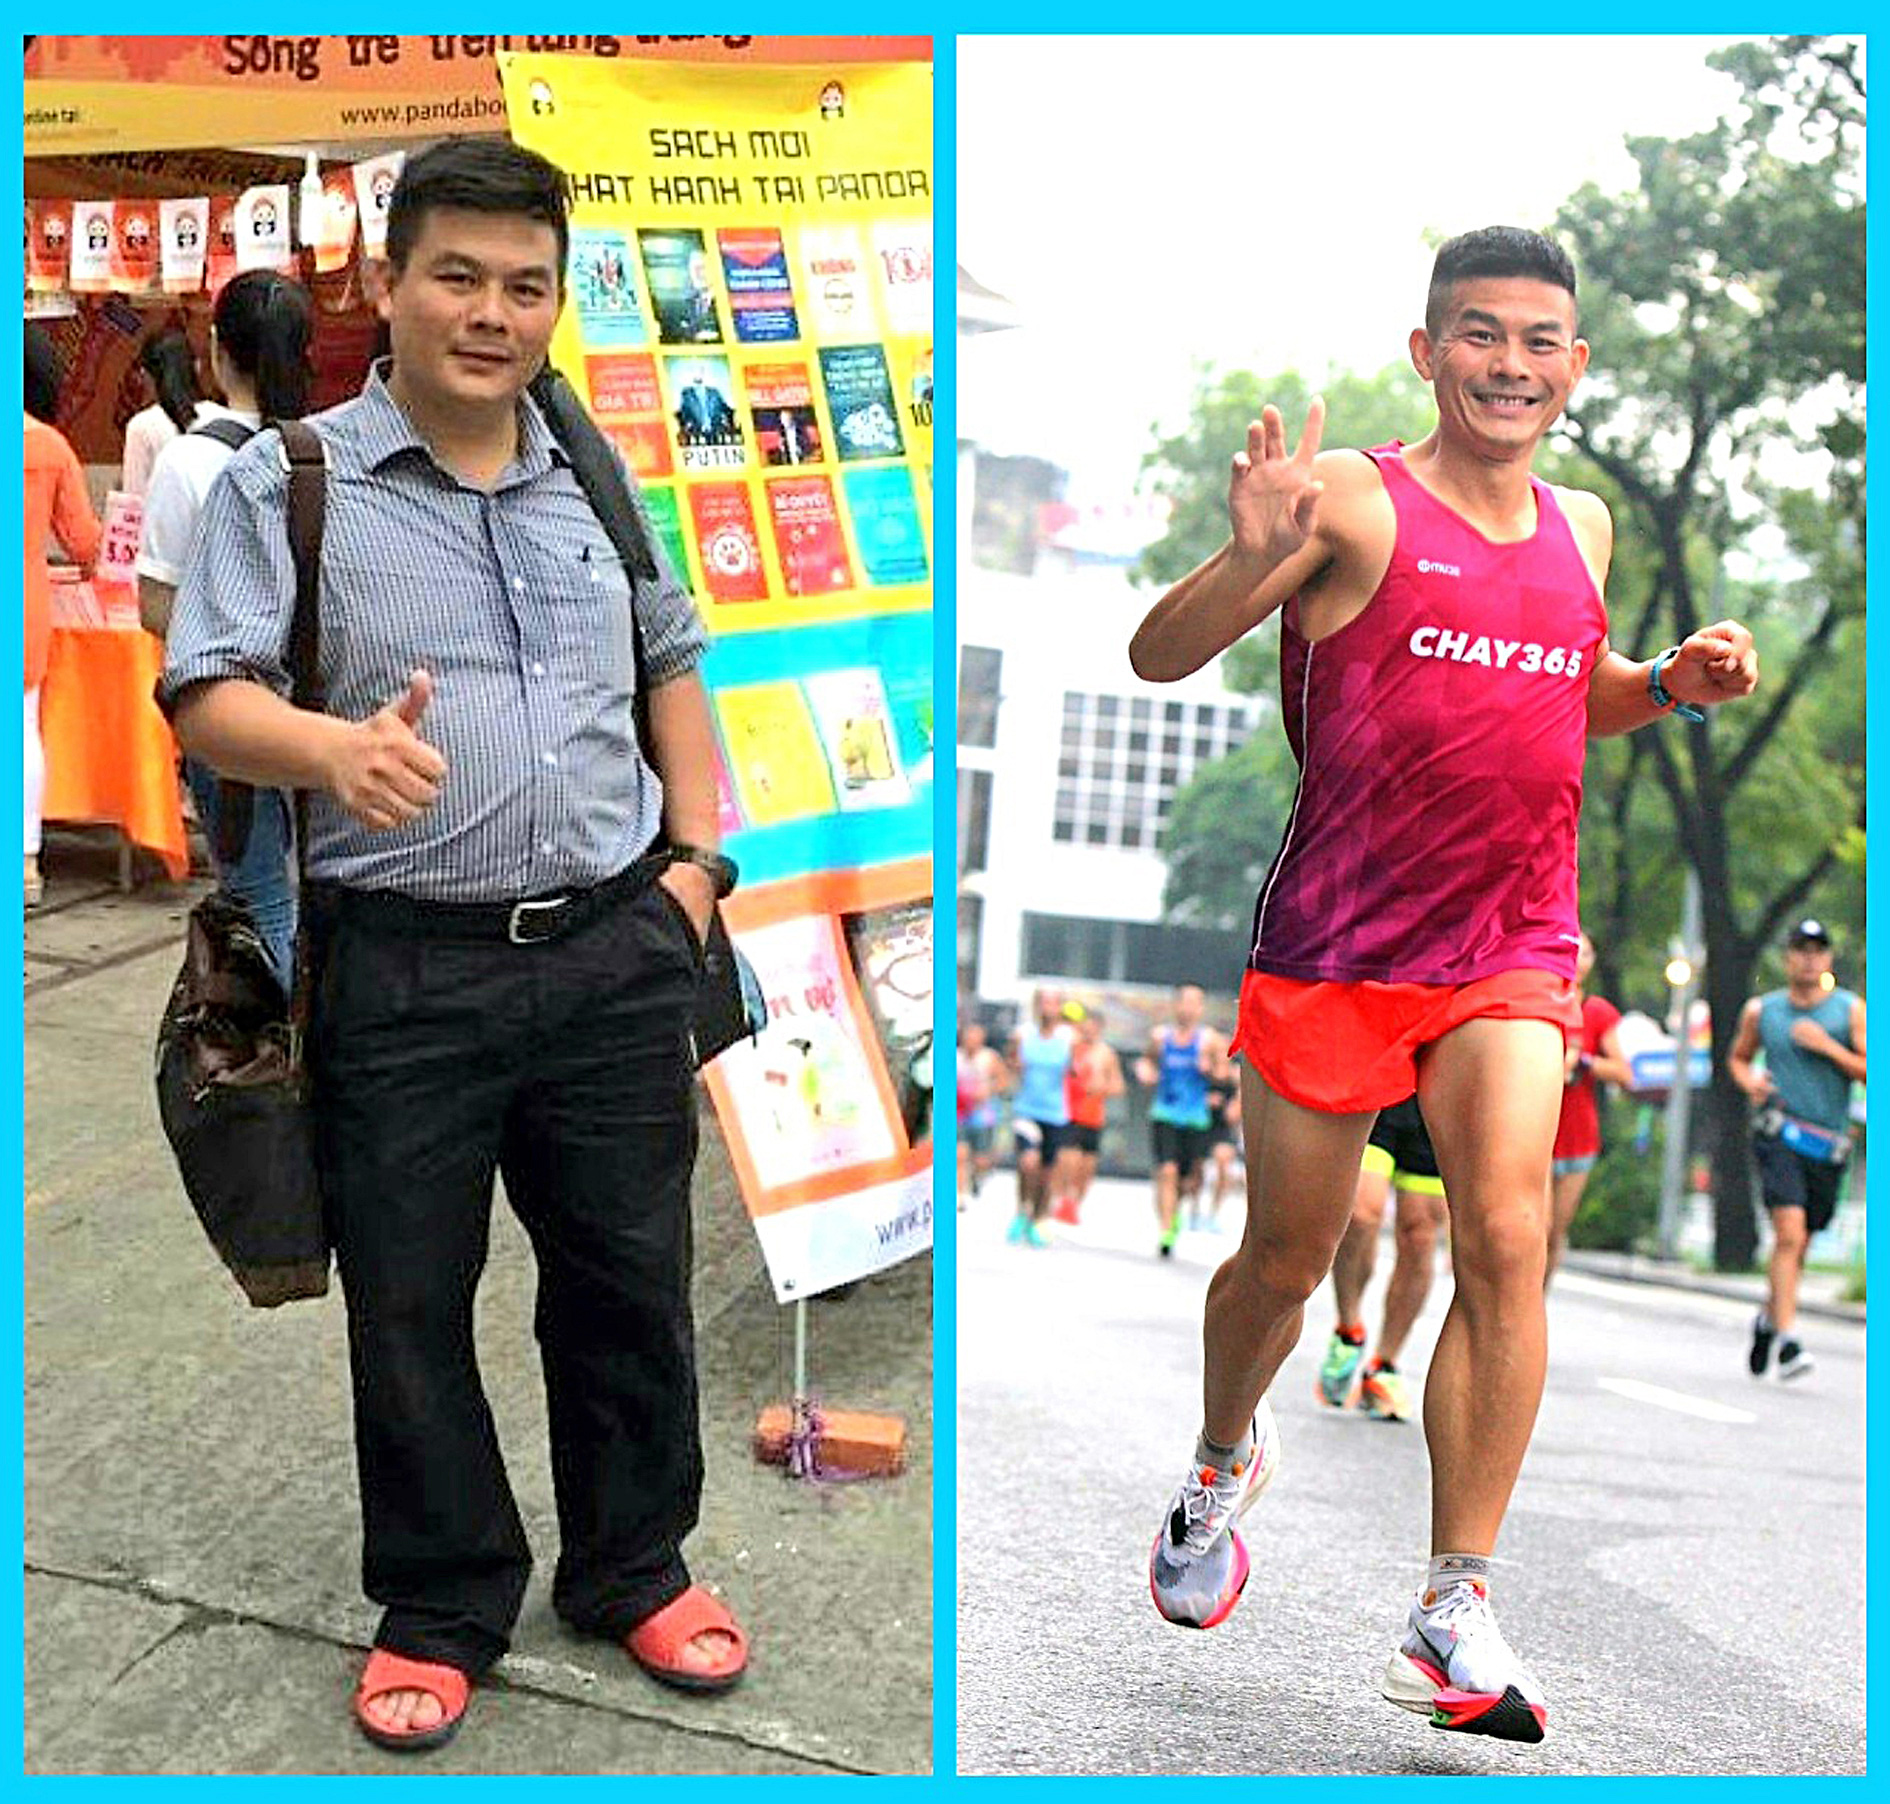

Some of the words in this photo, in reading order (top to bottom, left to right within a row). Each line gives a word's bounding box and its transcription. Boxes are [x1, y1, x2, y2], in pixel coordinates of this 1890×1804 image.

[649, 128, 736, 159] SACH
[569, 173, 634, 204] HAT
[649, 175, 742, 204] HANH
[816, 170, 930, 203] PANDA
[682, 448, 745, 467] PUTIN
[1408, 625, 1583, 679] CHAY365
